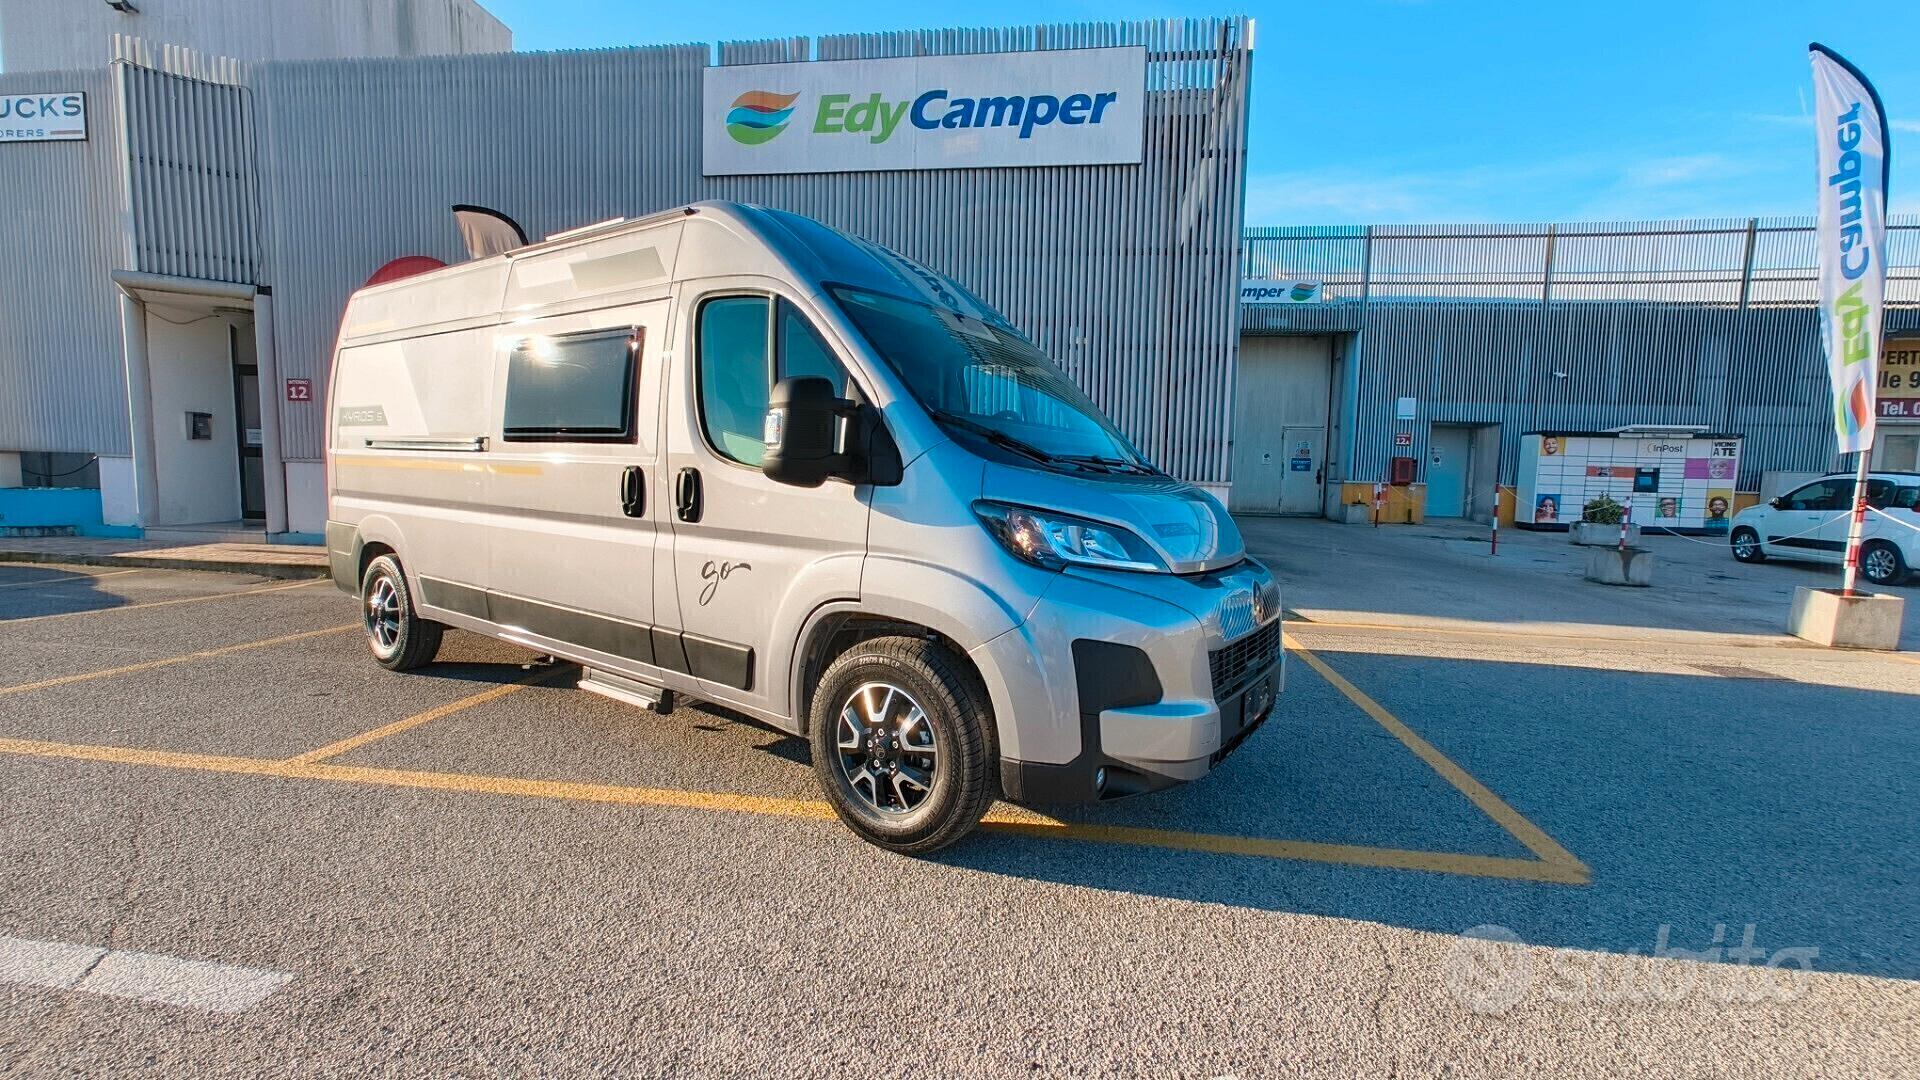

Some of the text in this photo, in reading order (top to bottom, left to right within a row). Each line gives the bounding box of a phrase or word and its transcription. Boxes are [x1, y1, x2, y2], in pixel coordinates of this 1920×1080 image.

[813, 89, 1117, 145] EdyCamper
[1828, 102, 1870, 367] EdyCamper
[289, 386, 308, 399] 12
[1881, 402, 1908, 415] Tel.
[1713, 448, 1736, 457] A TE
[699, 560, 752, 606] go
